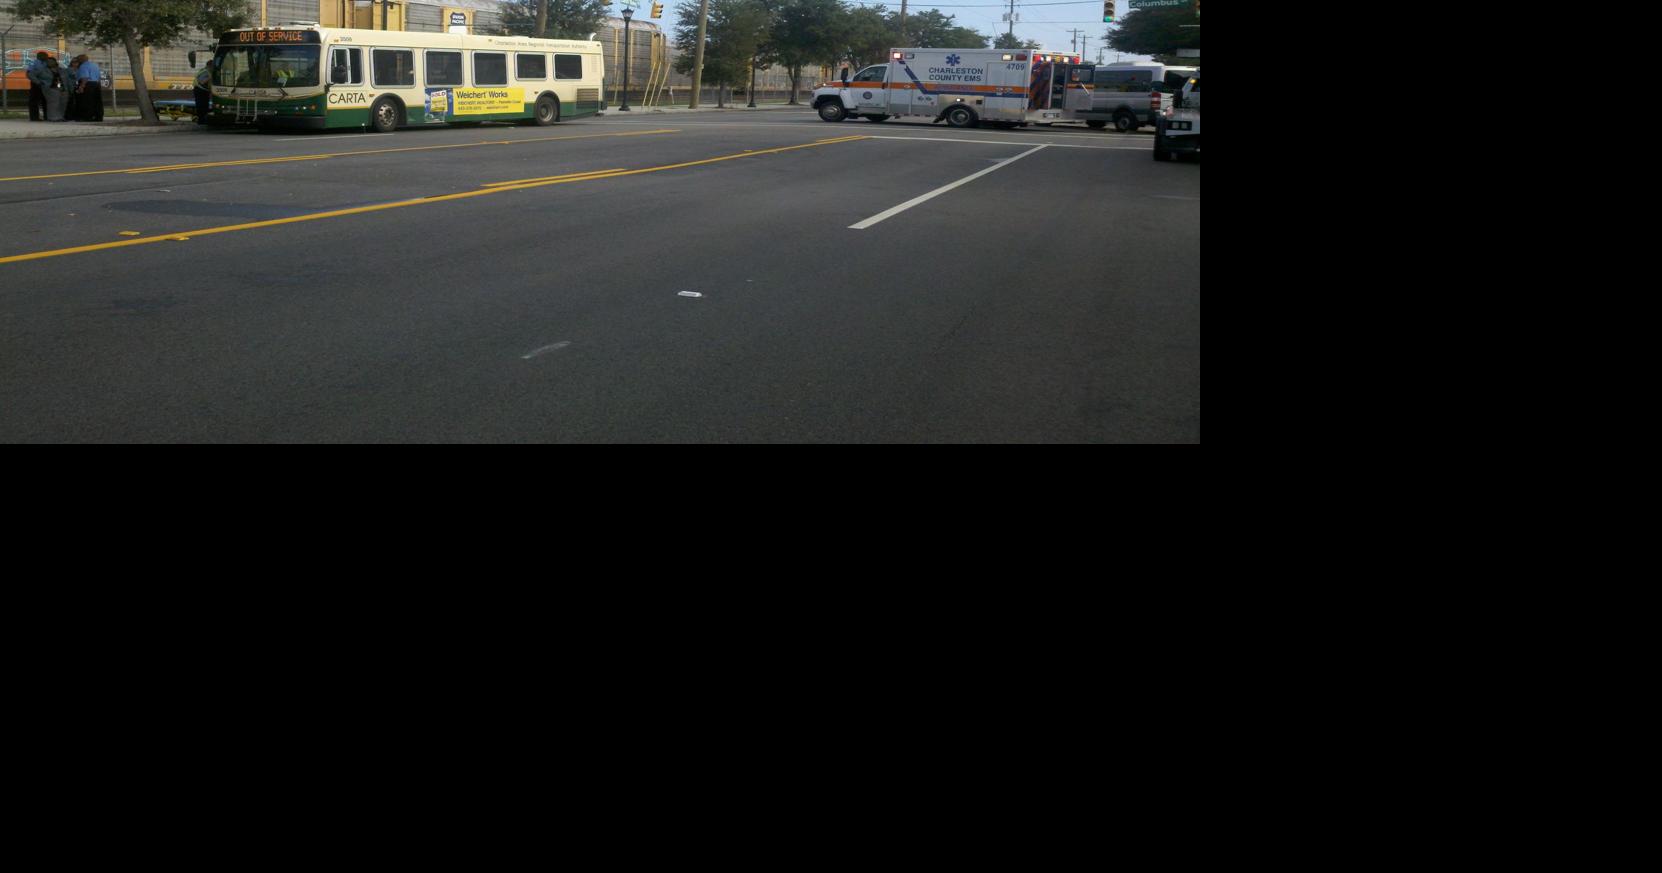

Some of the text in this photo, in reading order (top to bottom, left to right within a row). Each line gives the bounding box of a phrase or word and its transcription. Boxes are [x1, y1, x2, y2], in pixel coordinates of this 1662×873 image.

[1130, 0, 1179, 8] Columbus
[240, 31, 303, 42] OUT OF SERVICE
[928, 67, 983, 75] CHARLESTON
[1006, 63, 1025, 71] 4709
[488, 90, 509, 98] Works
[328, 93, 366, 104] CARTA
